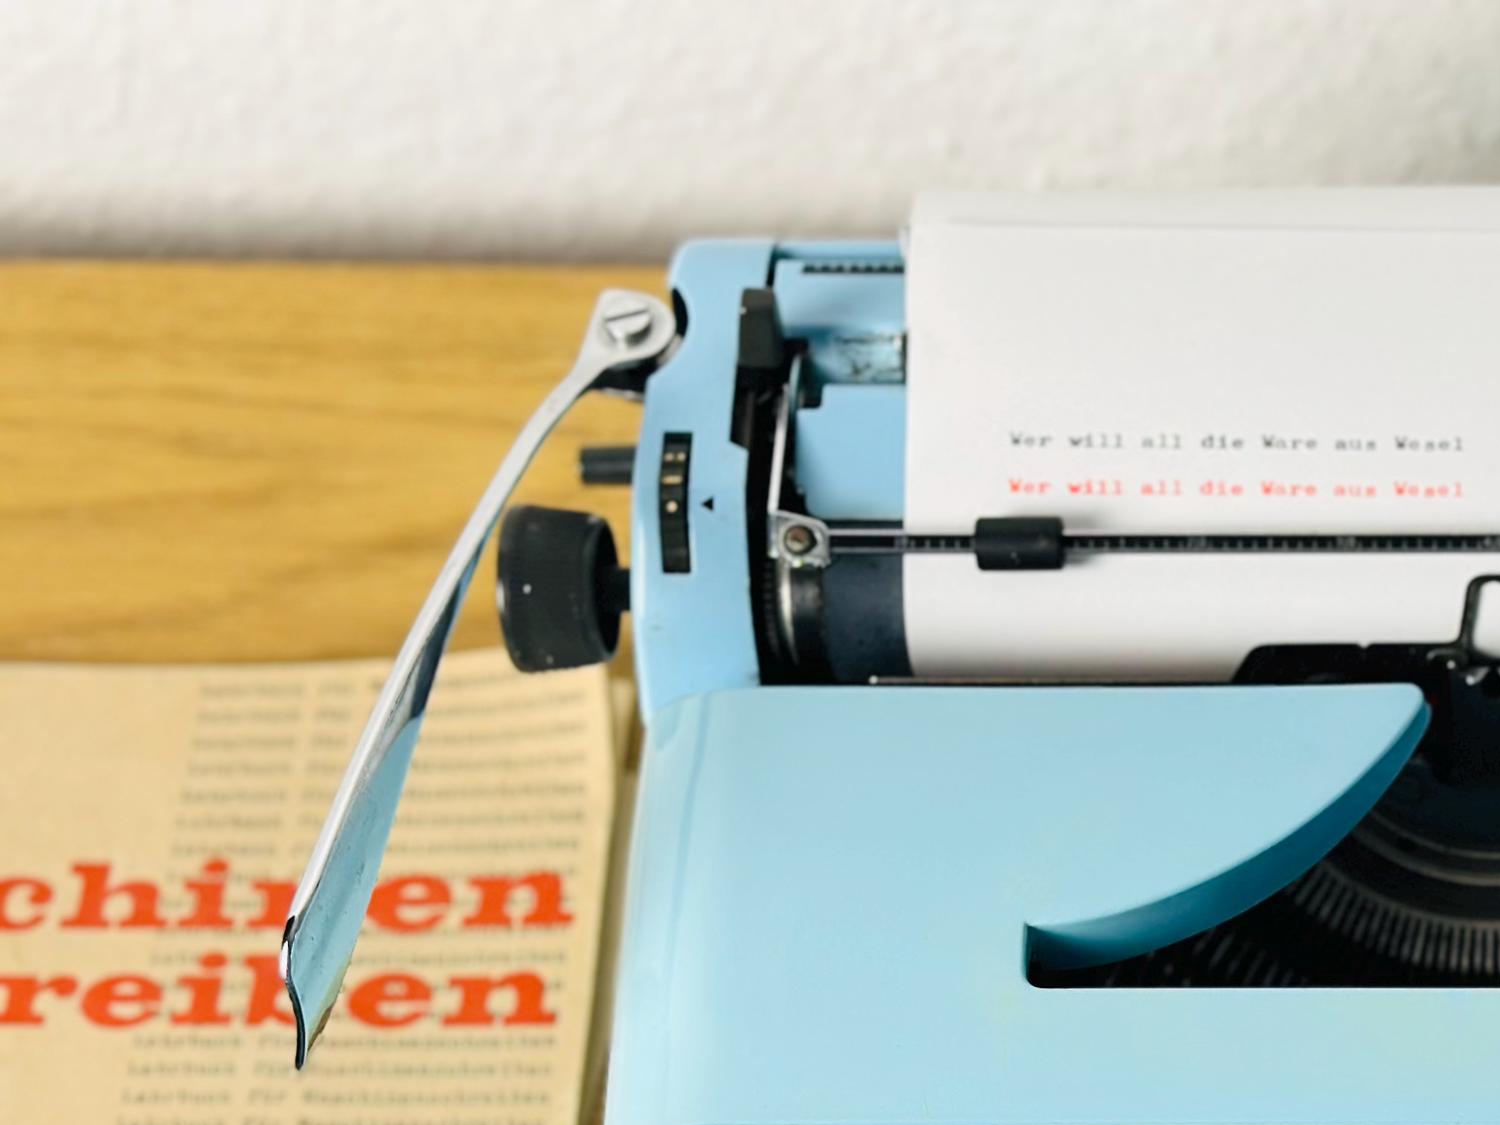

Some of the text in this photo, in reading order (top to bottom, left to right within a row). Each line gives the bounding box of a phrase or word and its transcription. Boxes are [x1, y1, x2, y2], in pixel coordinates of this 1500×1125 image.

[1010, 433, 1462, 452] Wer will all die Ware aus Wesel
[1009, 479, 1462, 498] Wer will all die Ware aus Wesel
